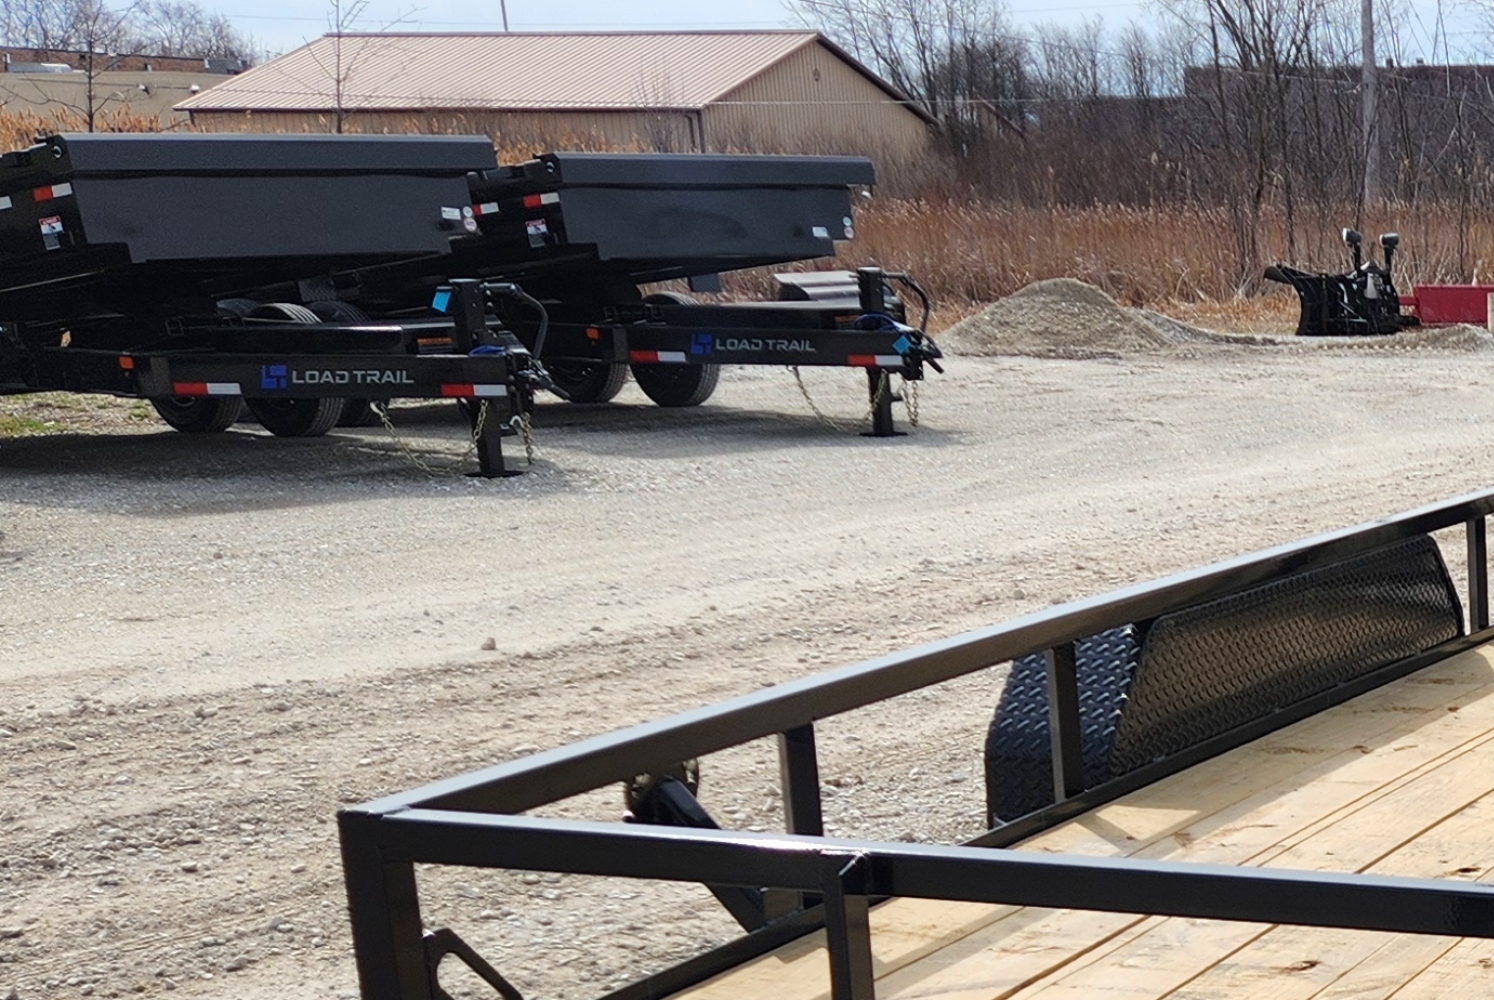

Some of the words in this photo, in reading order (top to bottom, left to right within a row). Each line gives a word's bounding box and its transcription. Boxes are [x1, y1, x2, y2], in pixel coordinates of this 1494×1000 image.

[715, 338, 763, 351] LOAD
[766, 339, 817, 352] TRAIL
[292, 370, 349, 384] LOAD
[352, 370, 415, 384] TRAIL
